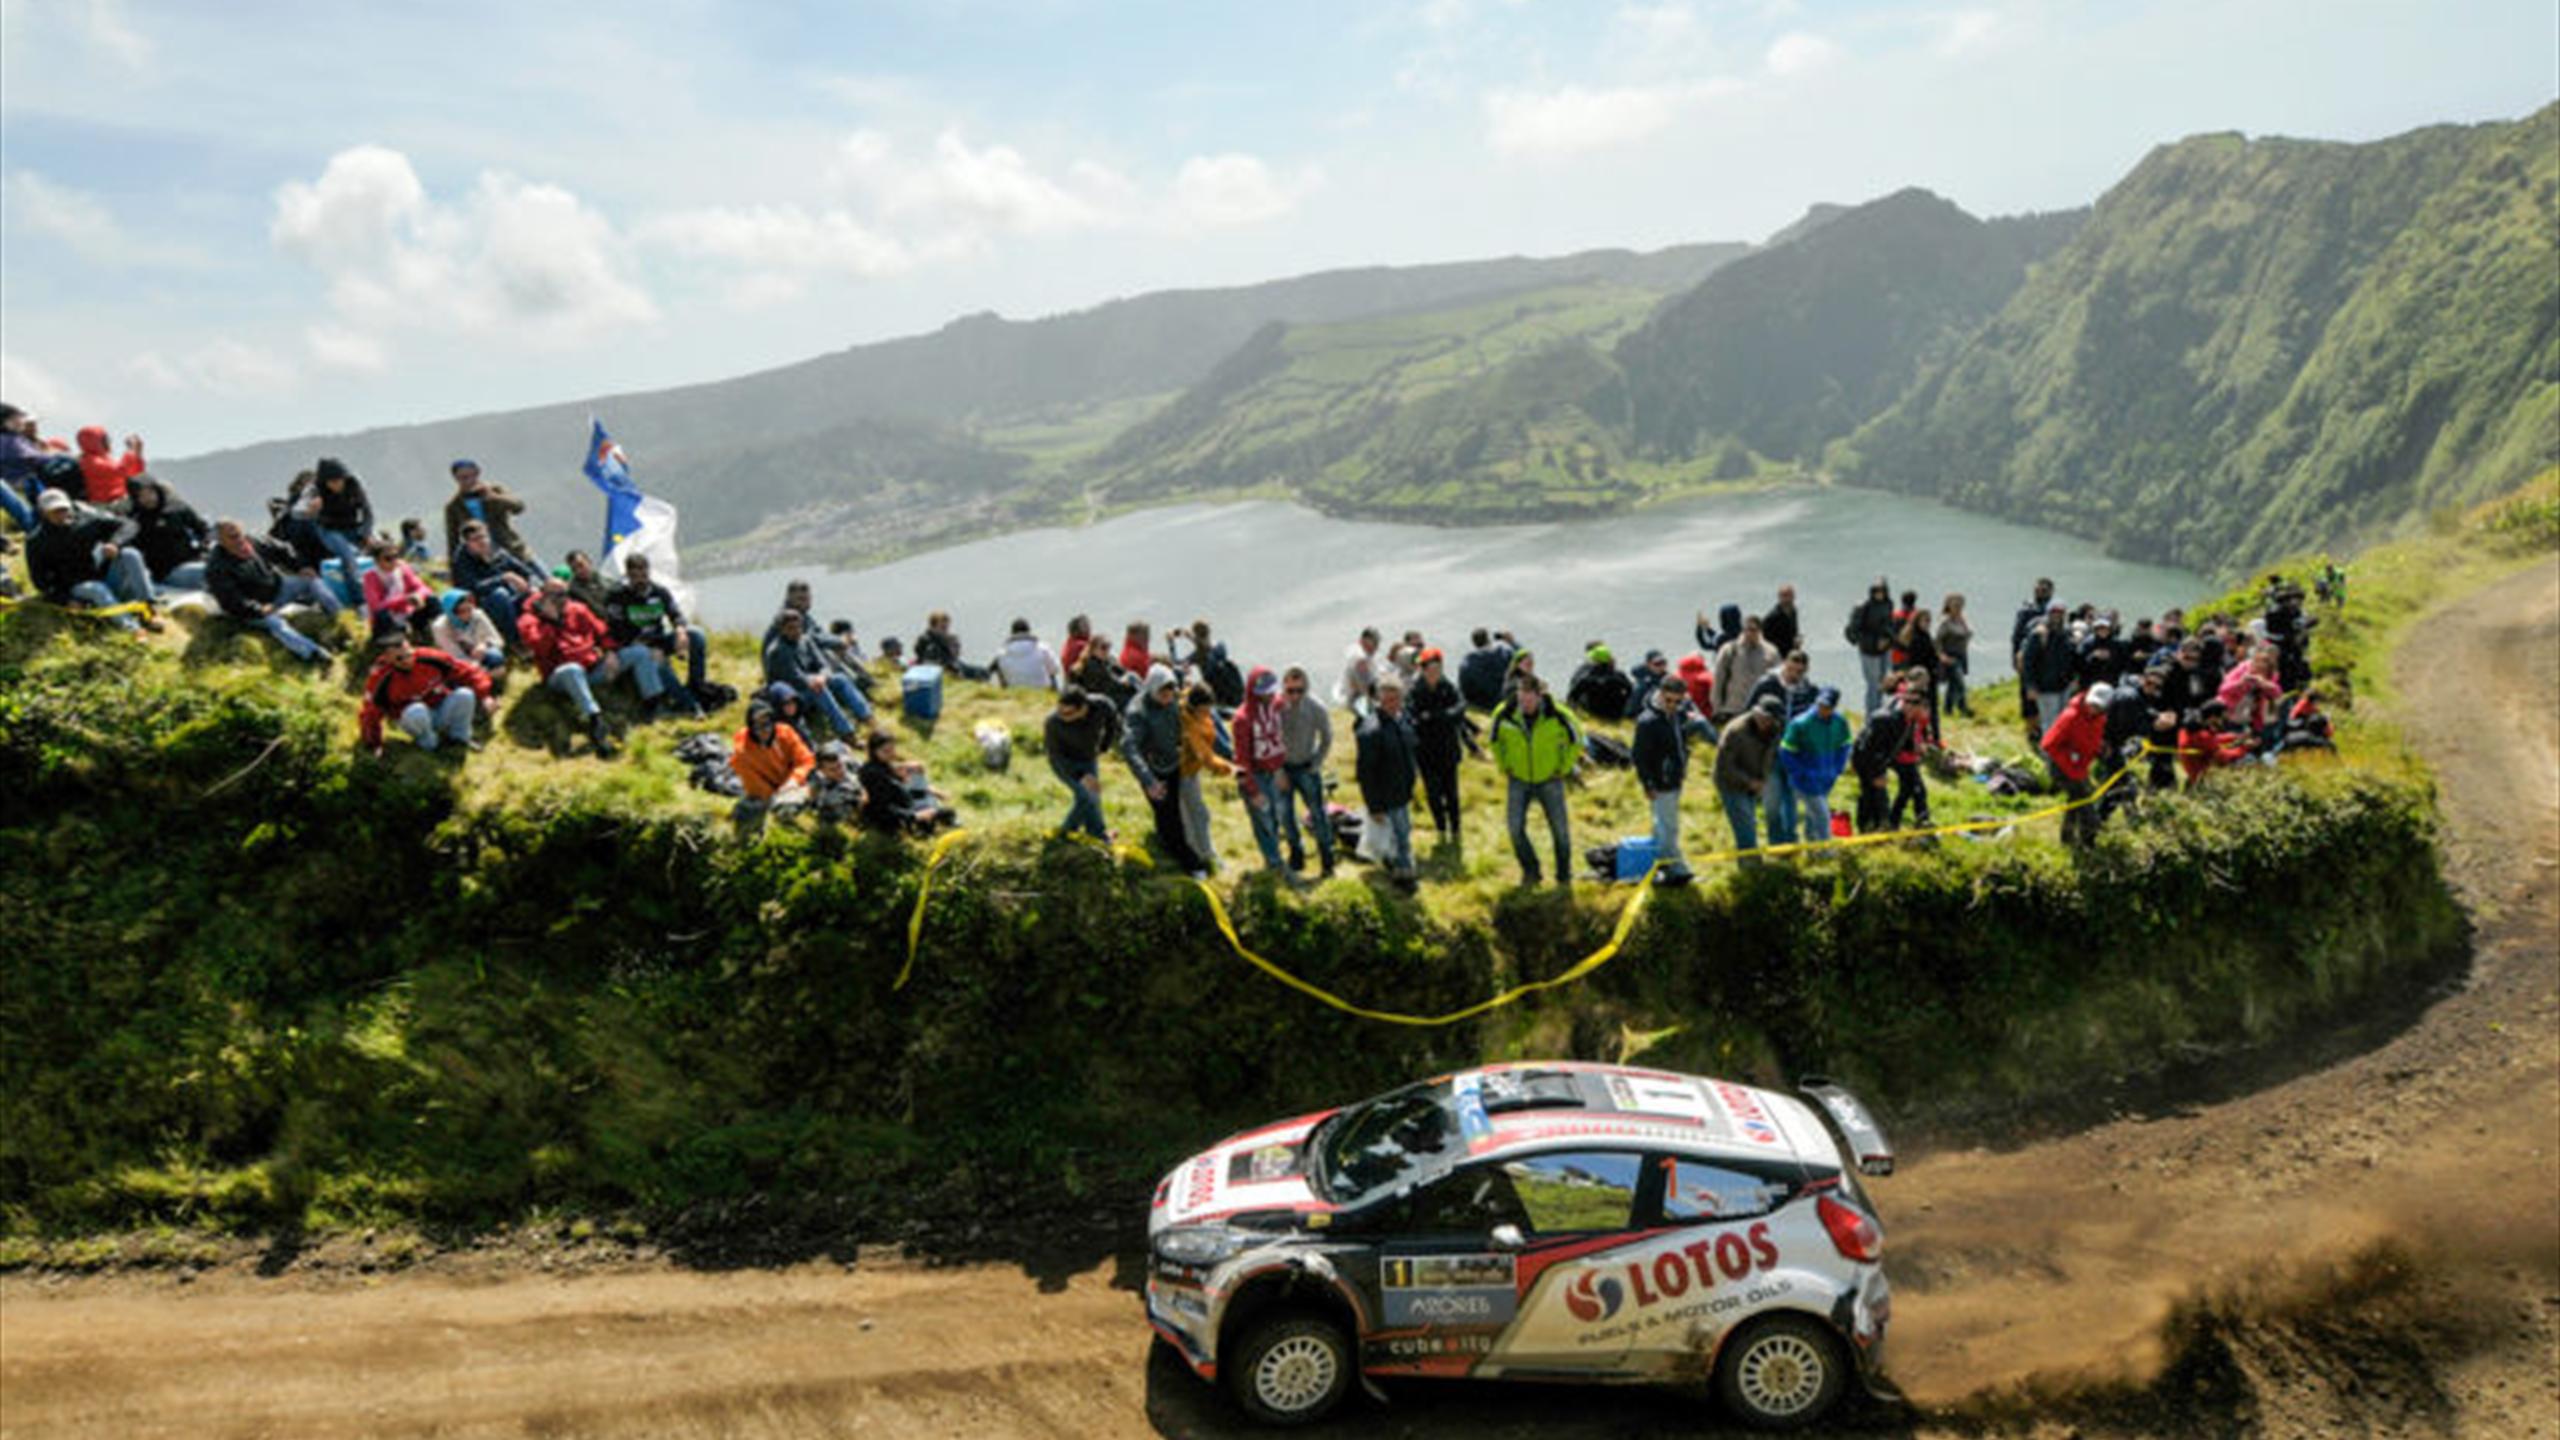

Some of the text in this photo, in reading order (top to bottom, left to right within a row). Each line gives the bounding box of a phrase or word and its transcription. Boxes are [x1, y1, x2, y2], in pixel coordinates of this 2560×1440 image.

[1659, 1157, 1677, 1199] 1
[1393, 1259, 1406, 1287] 1
[1628, 1222, 1779, 1307] LOTOS
[1664, 1296, 1743, 1323] MOTOR
[1746, 1278, 1793, 1303] OILS
